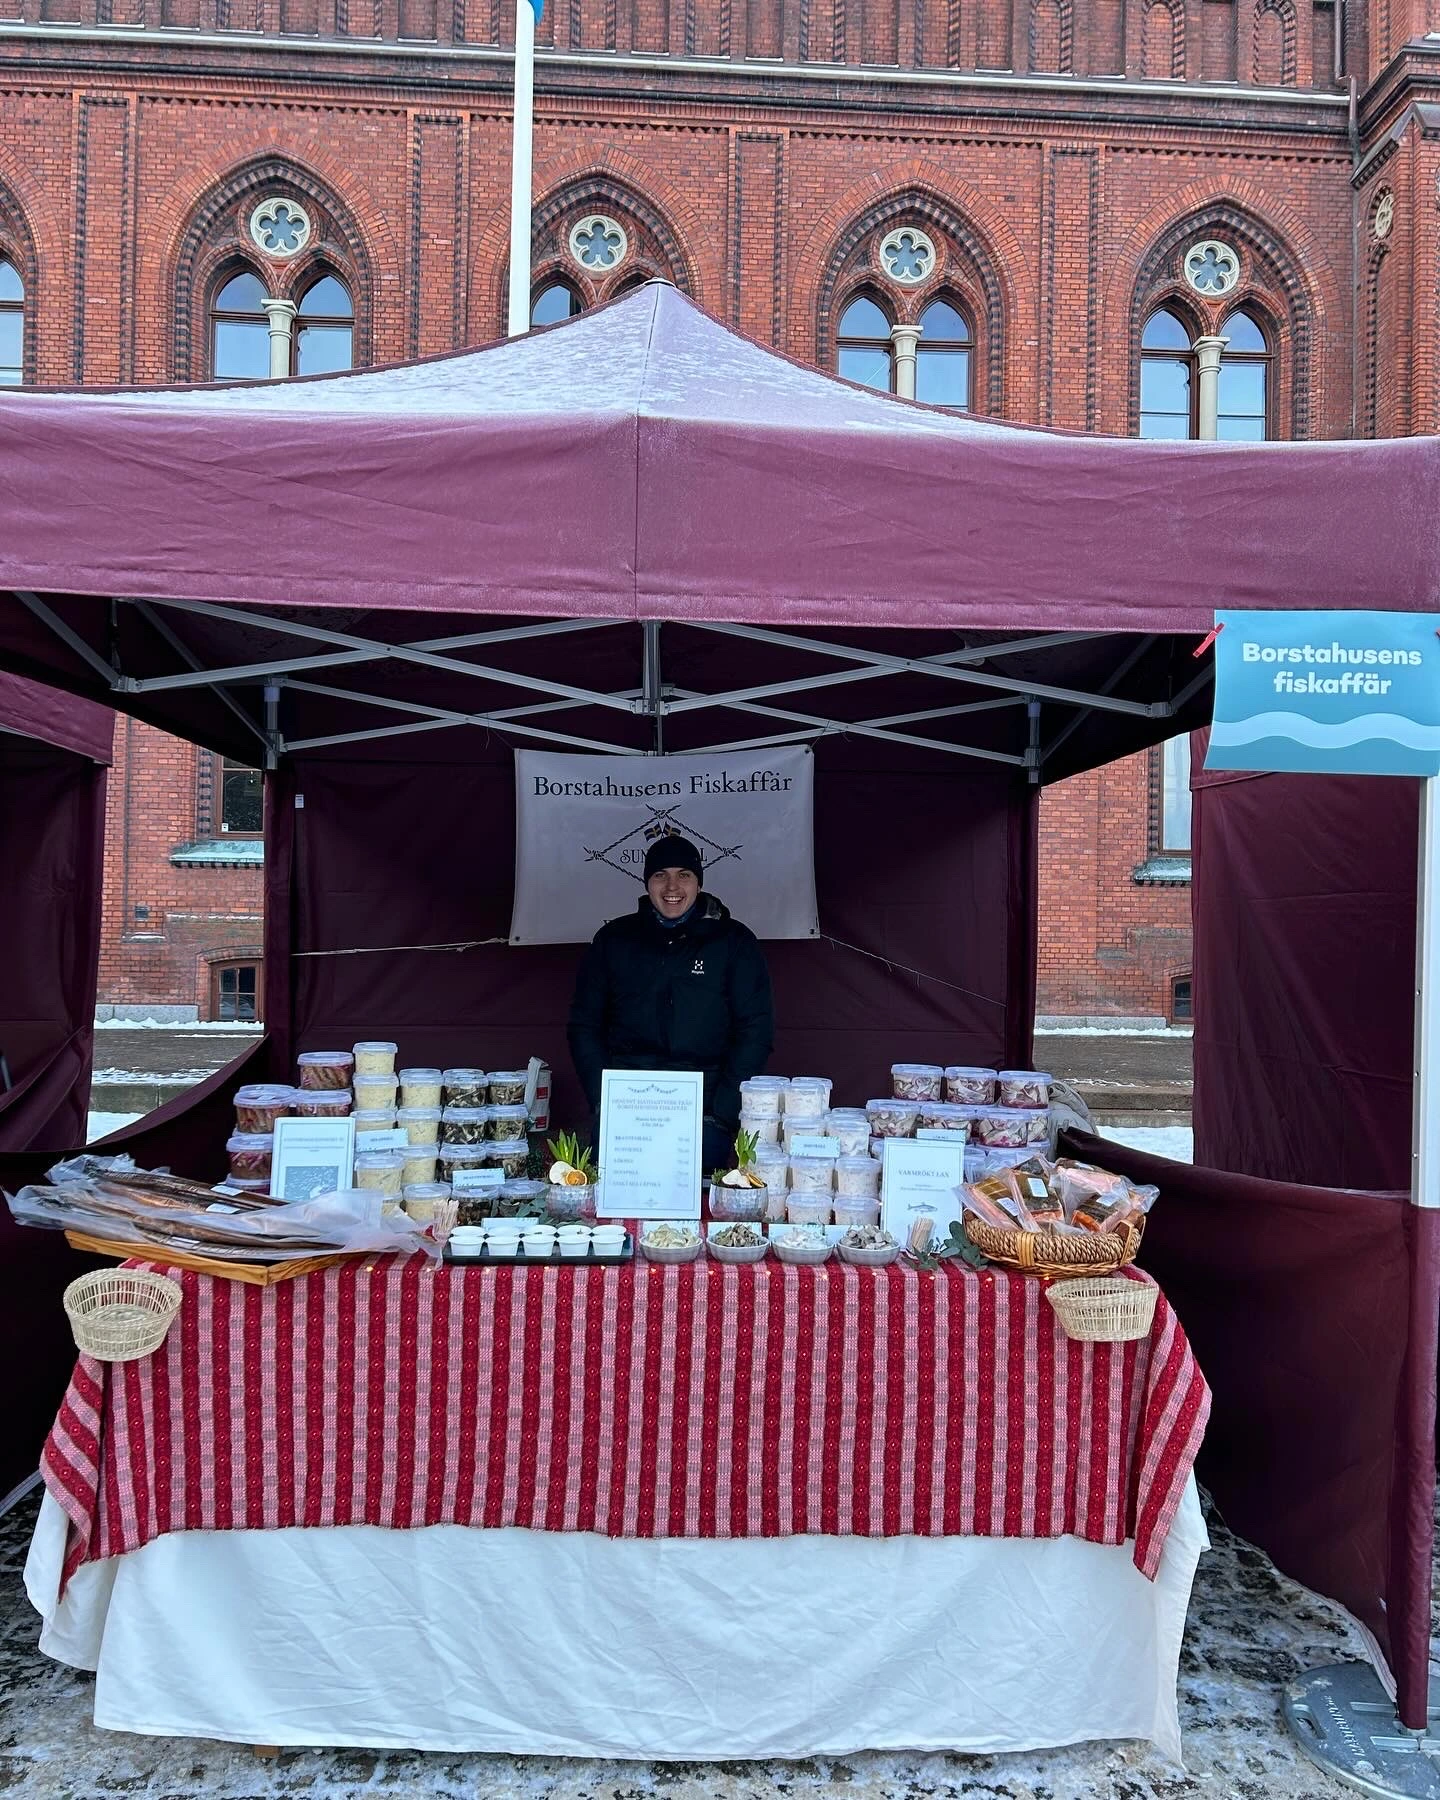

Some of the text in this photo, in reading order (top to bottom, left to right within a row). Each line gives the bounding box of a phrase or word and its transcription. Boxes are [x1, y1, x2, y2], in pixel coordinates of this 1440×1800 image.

[1242, 642, 1423, 666] Borstahusens
[1273, 671, 1392, 695] fiskaffär
[533, 770, 793, 798] Borstahusens Fiskaffär
[898, 1168, 935, 1177] VARMRÖKT
